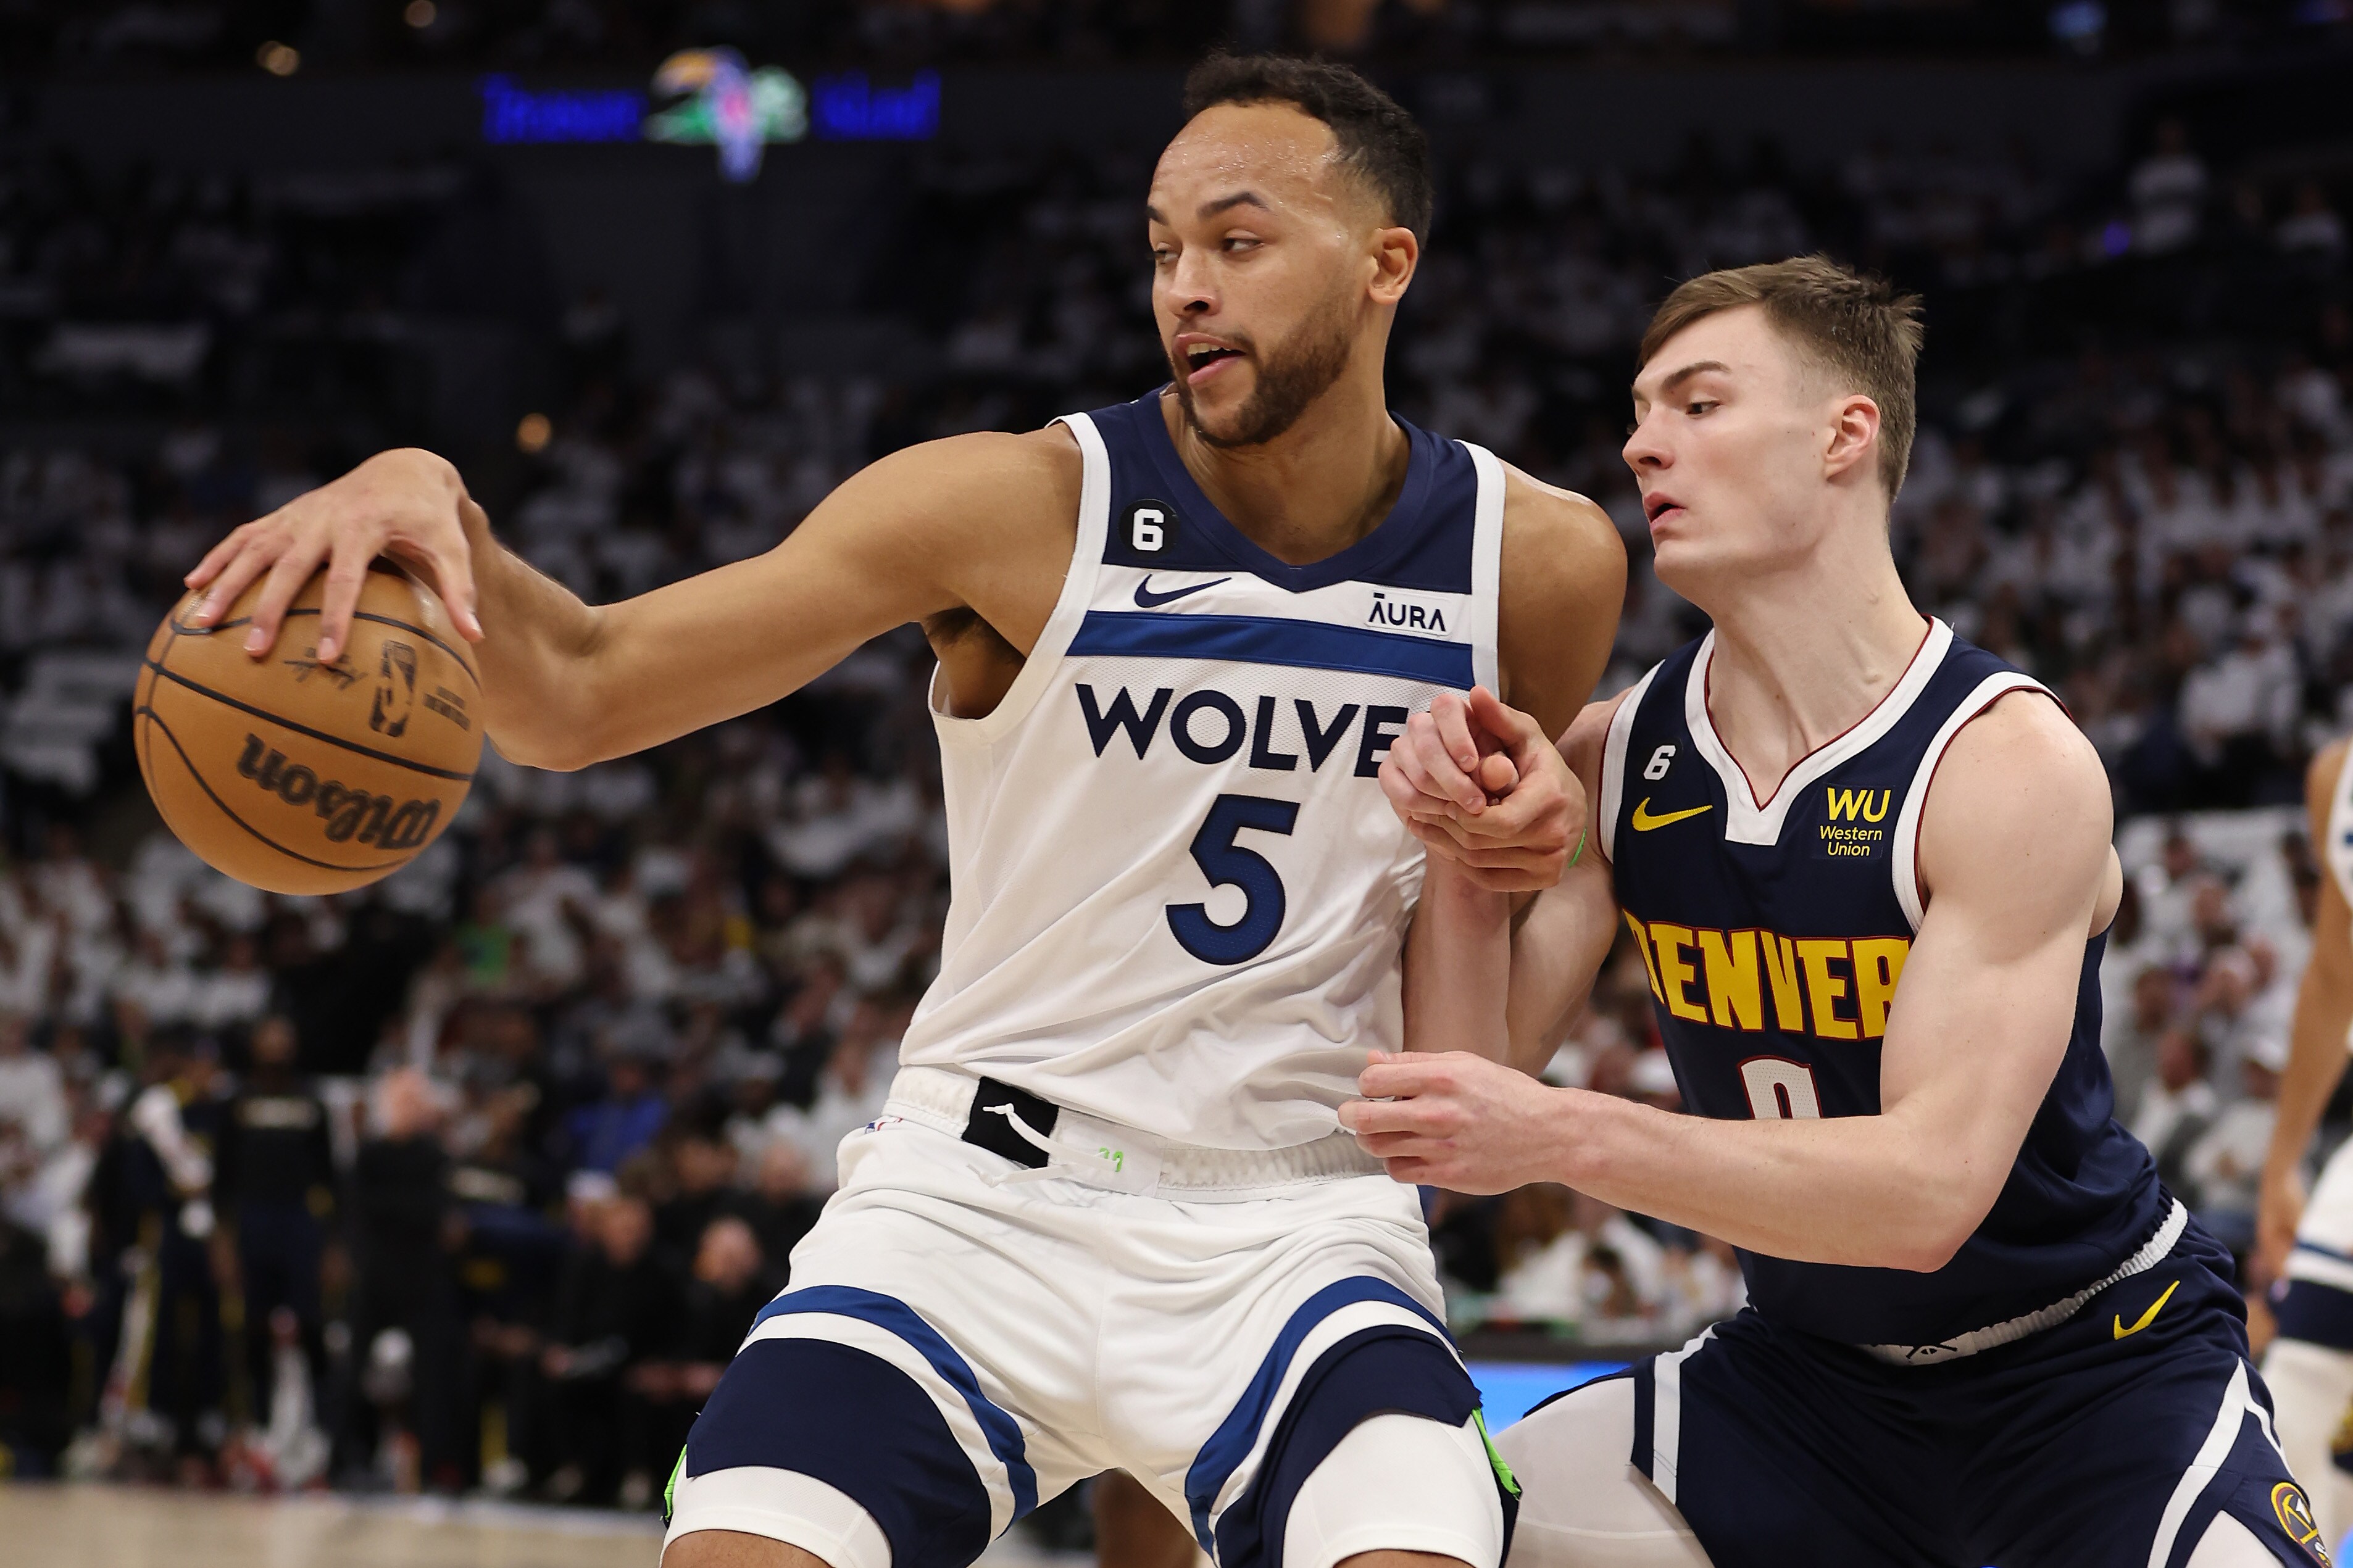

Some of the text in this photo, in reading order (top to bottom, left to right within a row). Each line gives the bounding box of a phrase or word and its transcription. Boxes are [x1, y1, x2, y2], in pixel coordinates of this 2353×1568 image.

[1132, 508, 1165, 552] 6
[1075, 683, 1414, 778] WOLVE
[1643, 745, 1676, 781] 6
[236, 732, 441, 850] Wilson
[1827, 787, 1891, 823] WU
[1820, 825, 1883, 840] Western
[1827, 841, 1870, 857] Union
[1166, 794, 1301, 966] 5
